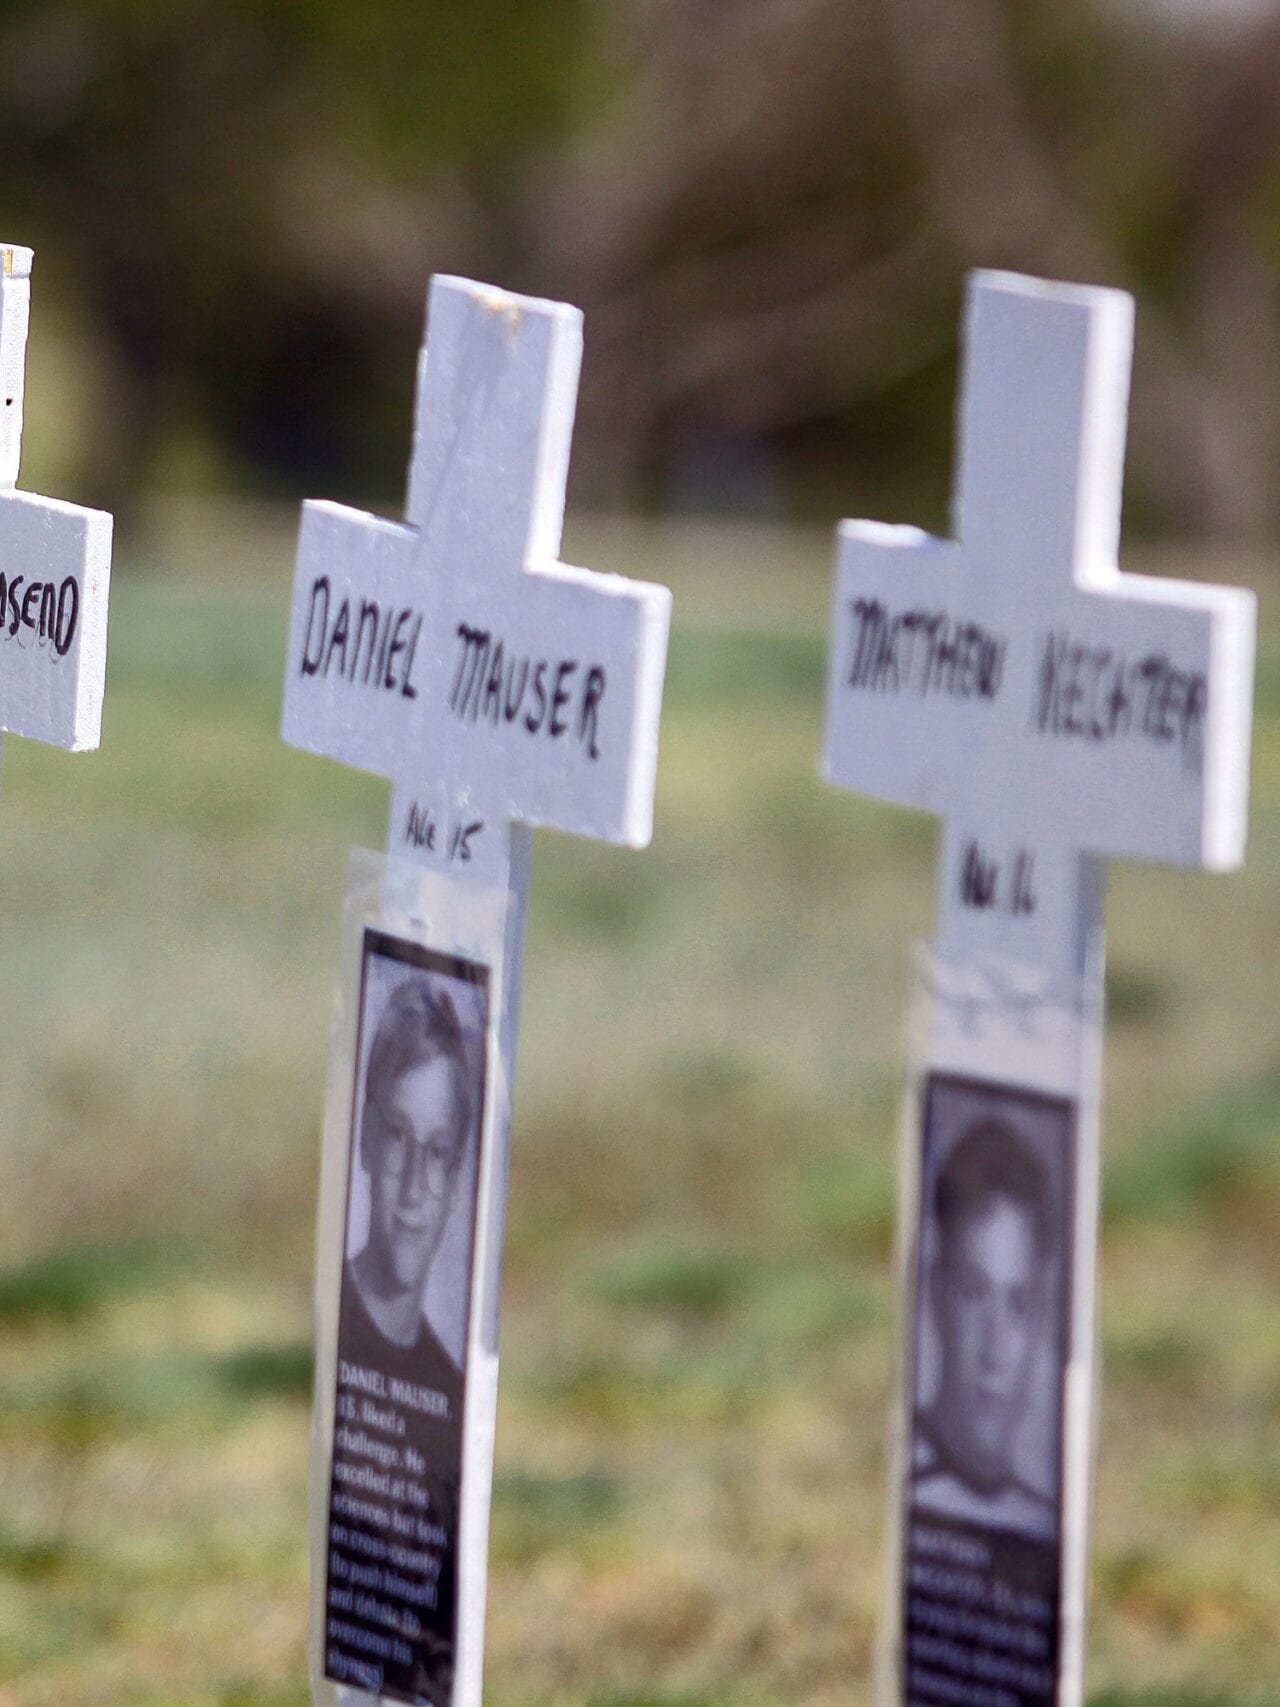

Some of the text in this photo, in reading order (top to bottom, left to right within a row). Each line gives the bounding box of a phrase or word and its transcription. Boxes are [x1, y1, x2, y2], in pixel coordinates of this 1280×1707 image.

[300, 573, 606, 760] DANIEL MAUSER
[406, 800, 484, 863] AGE 15
[340, 1360, 387, 1397] DANIEL
[363, 1401, 396, 1433] liked
